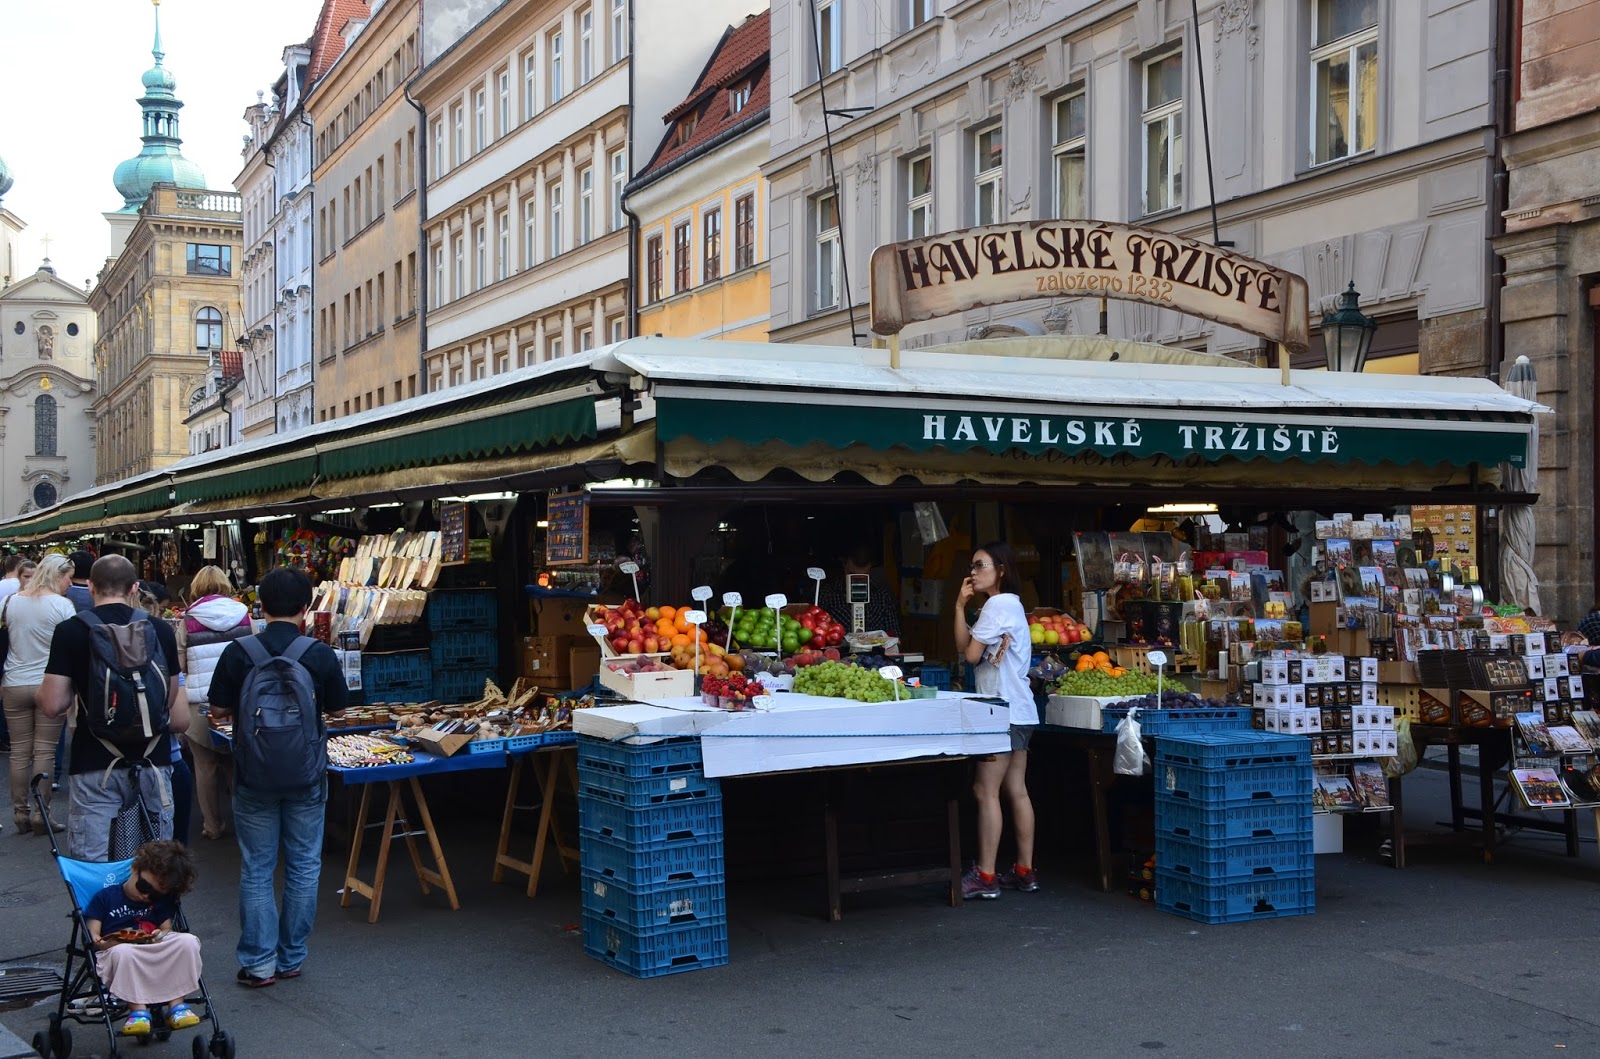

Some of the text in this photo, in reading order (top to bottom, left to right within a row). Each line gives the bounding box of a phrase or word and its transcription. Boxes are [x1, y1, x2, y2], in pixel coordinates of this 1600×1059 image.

[899, 223, 1282, 314] HAVELSKÉ TRŽIŠTĚ
[1036, 271, 1174, 302] založeno 1232
[922, 415, 1340, 454] HAVELSKÉ TRŽIŠTĚ
